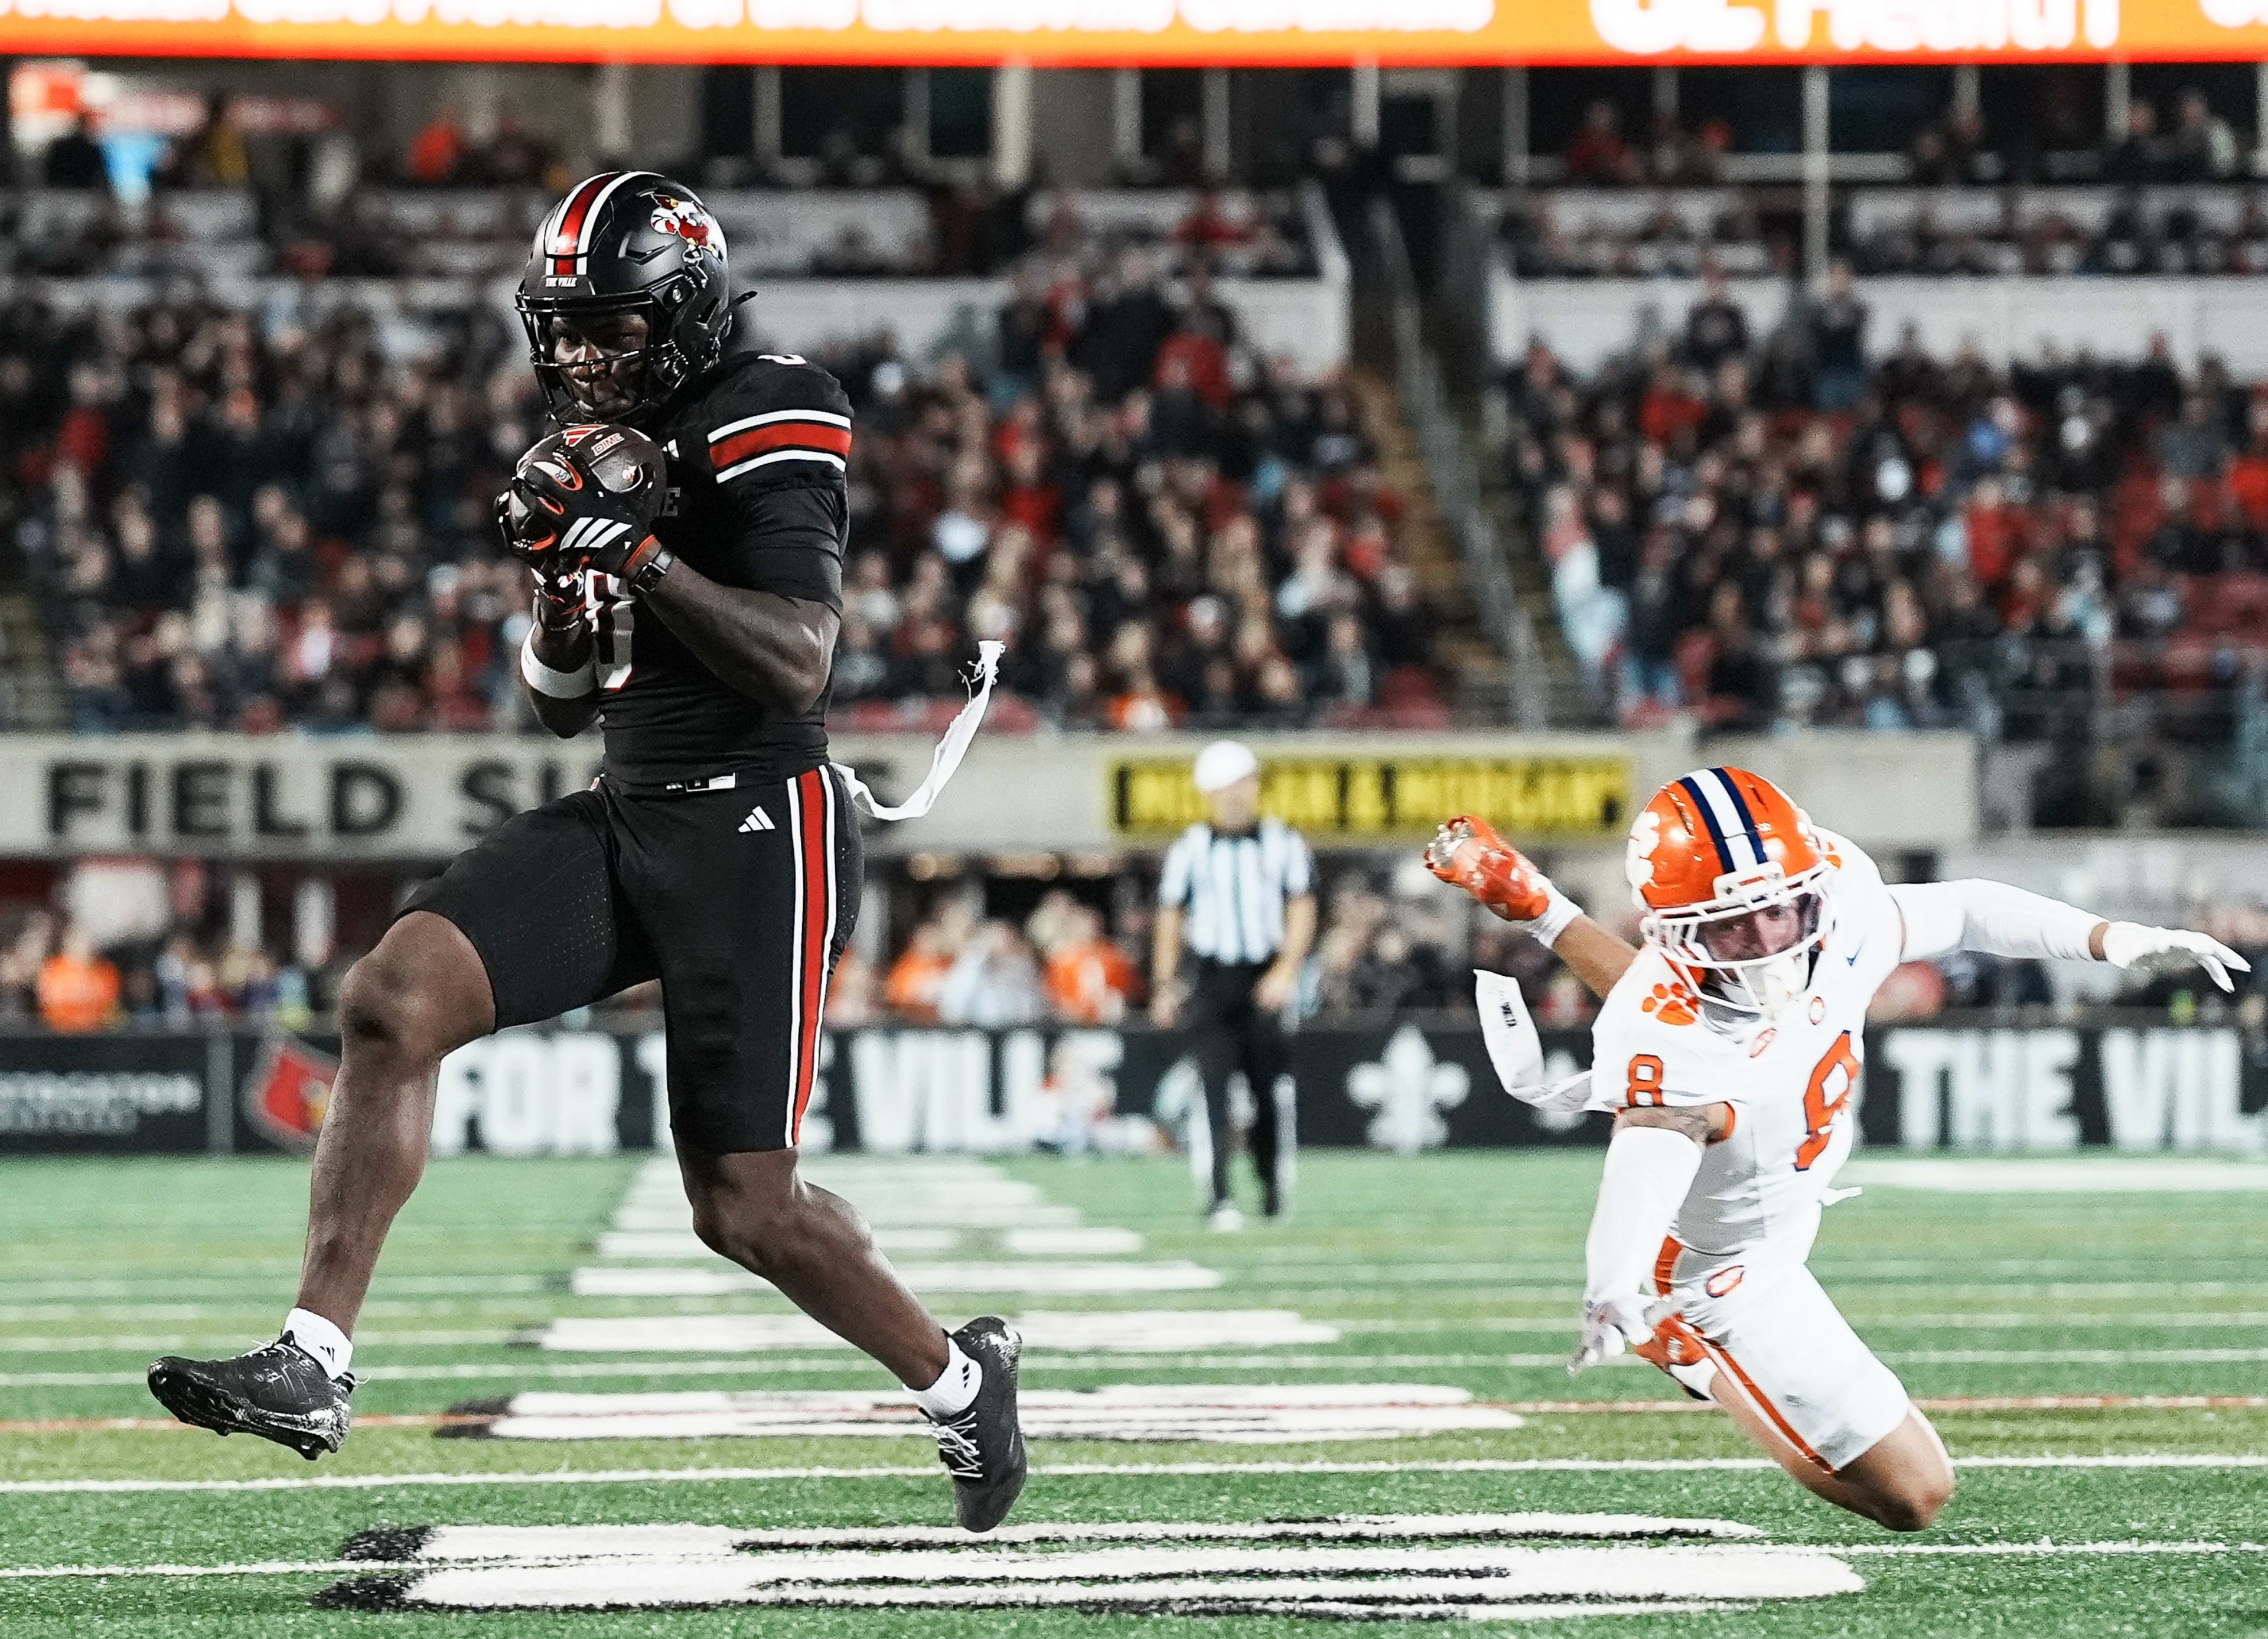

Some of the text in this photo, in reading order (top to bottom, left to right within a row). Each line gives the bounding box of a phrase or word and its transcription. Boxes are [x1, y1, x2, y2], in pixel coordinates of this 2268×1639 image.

[558, 277, 578, 288] VILLE
[591, 432, 625, 457] DIME
[46, 760, 405, 835] FIELD
[434, 1029, 621, 1152] FOR
[848, 1029, 1159, 1152] VILLE
[1625, 1054, 1664, 1107] 8
[1884, 1028, 2081, 1151] THE
